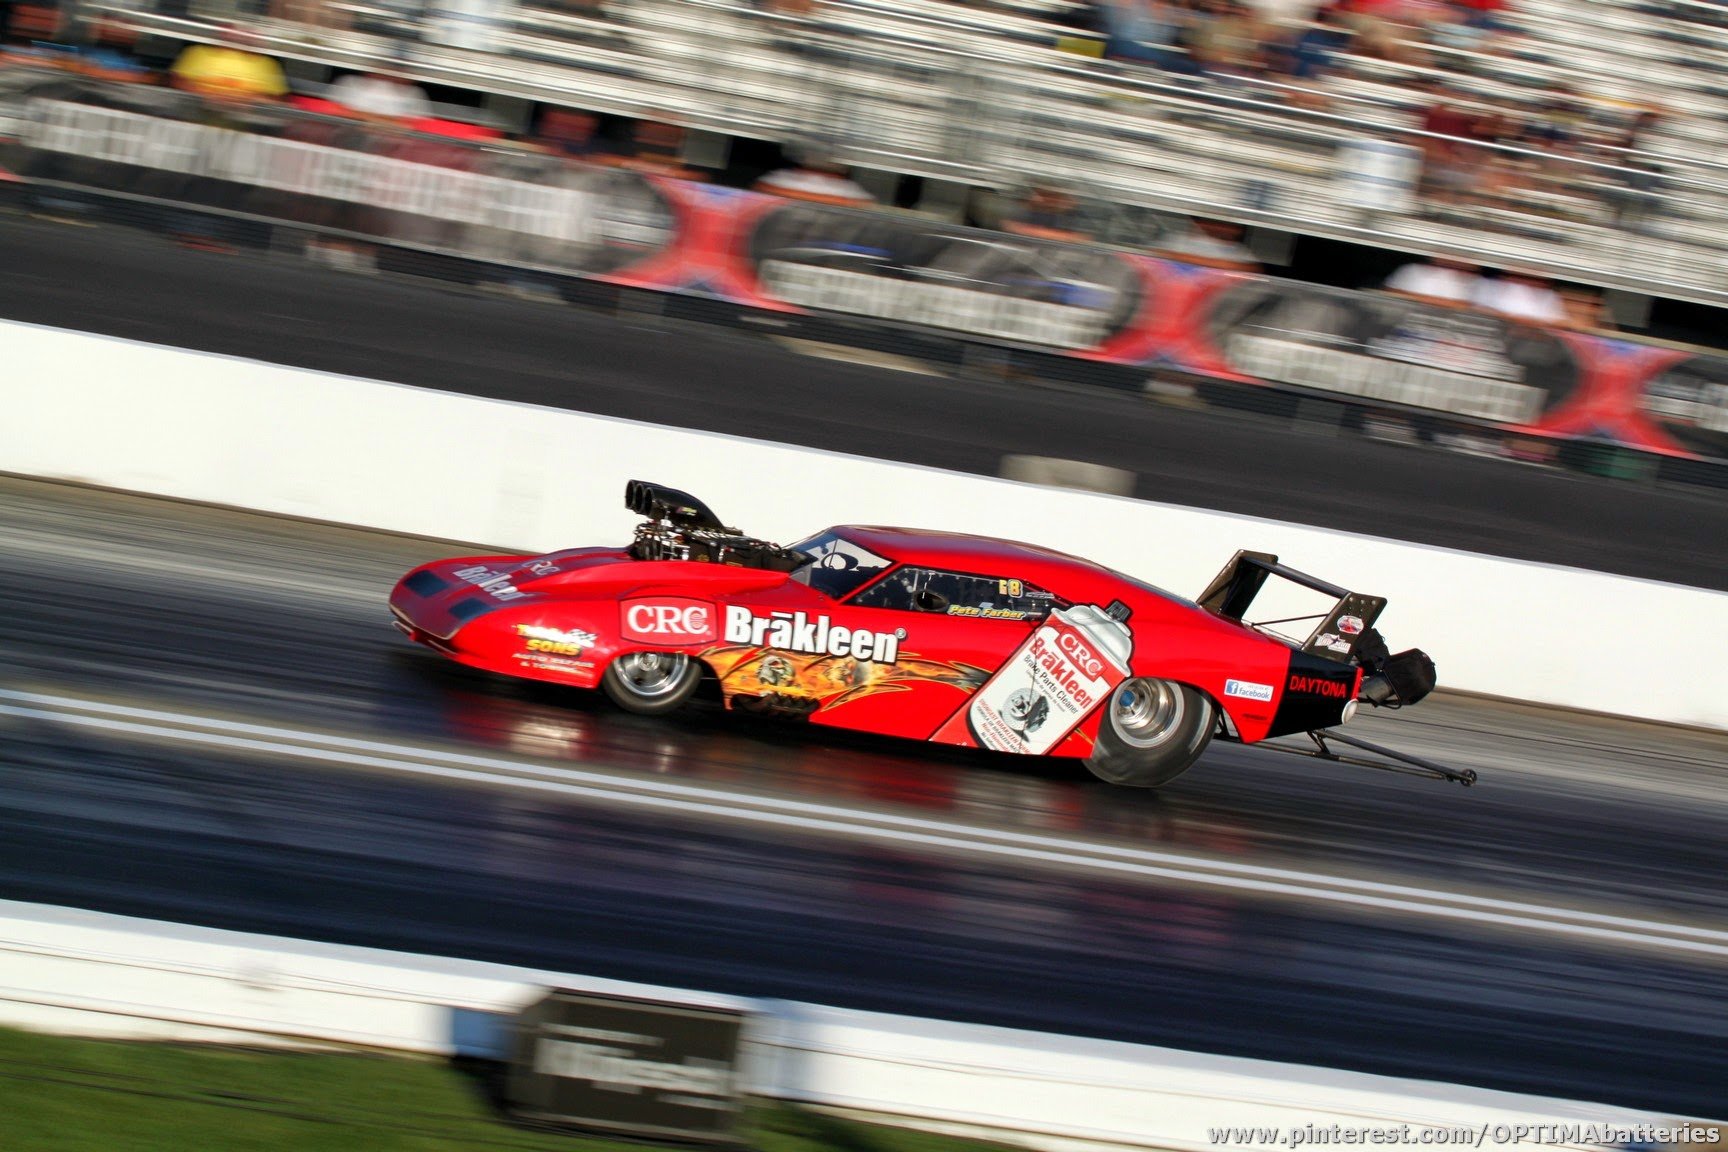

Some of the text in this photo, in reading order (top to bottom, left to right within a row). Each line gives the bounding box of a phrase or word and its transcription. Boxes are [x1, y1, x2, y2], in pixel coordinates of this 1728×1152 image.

[627, 604, 710, 635] CRC
[948, 604, 981, 617] Pete
[1060, 633, 1103, 676] CRC
[1039, 671, 1059, 693] Parts
[1055, 689, 1080, 715] Cleaner
[1239, 687, 1270, 699] facebook
[1289, 675, 1347, 698] DAYTONA
